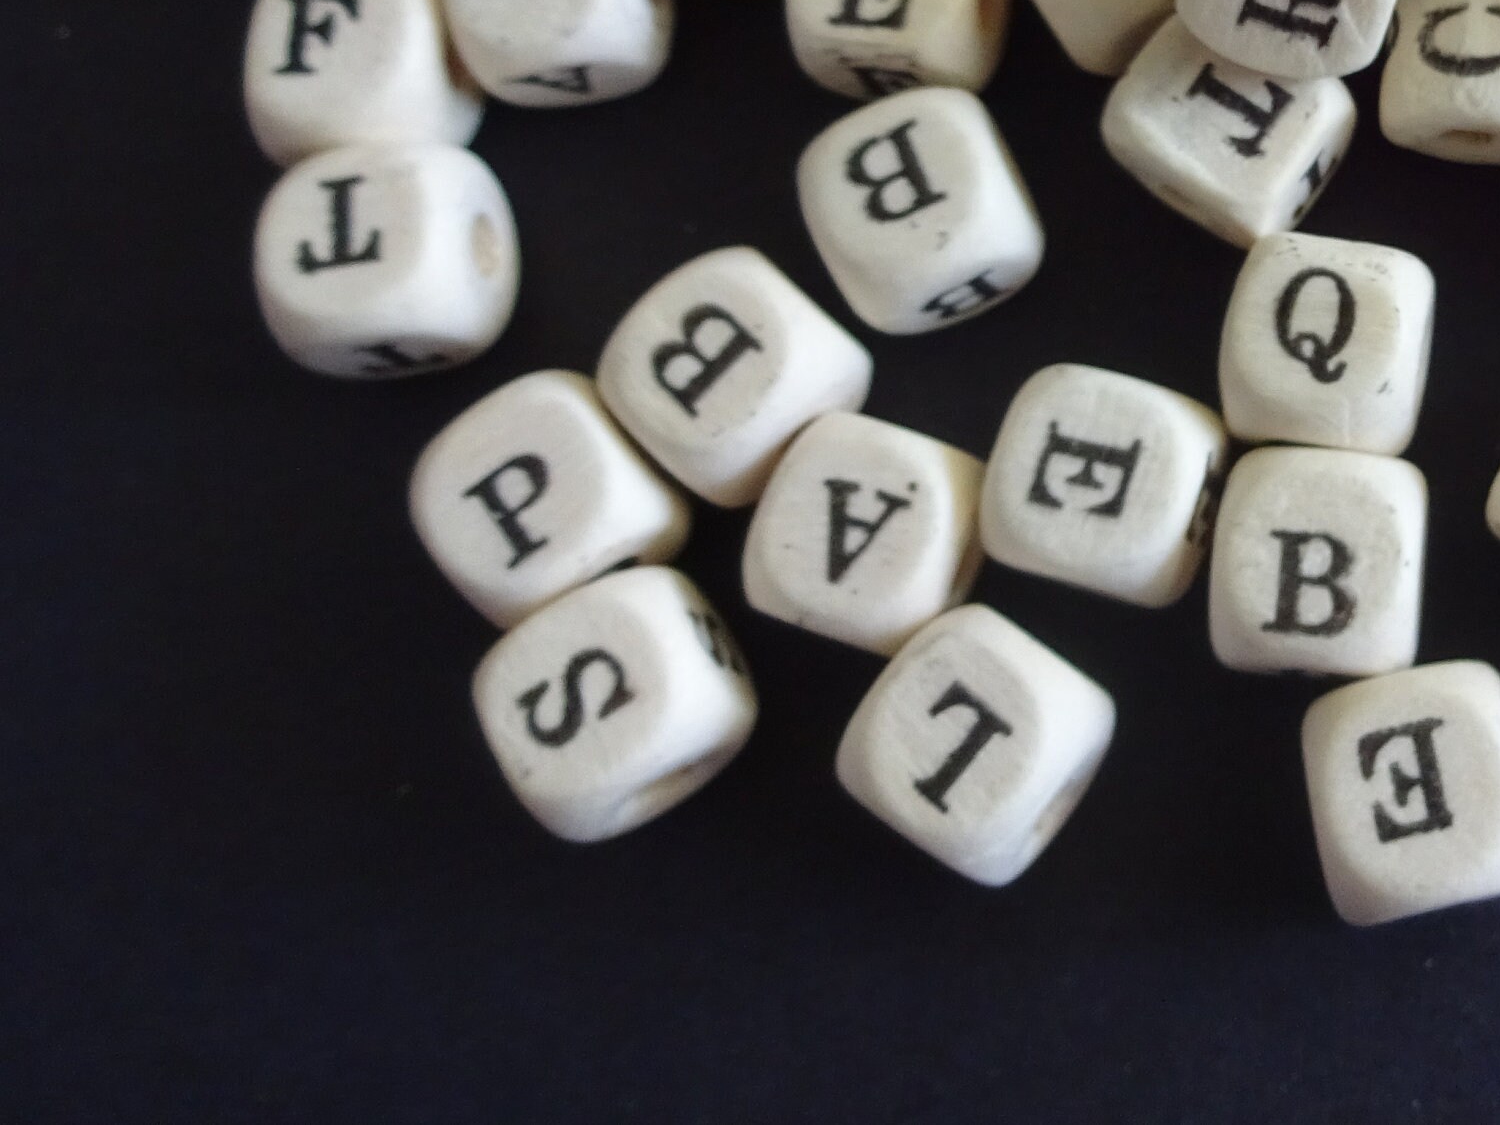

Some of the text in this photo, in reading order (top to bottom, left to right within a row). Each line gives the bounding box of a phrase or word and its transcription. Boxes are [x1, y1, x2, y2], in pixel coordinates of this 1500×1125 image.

[1185, 63, 1294, 160] T
[844, 116, 948, 223] B
[296, 175, 381, 274] T
[651, 302, 764, 419] B
[1274, 266, 1357, 385] Q
[461, 452, 552, 570] P
[1027, 418, 1143, 519] E
[822, 477, 912, 586] A
[1261, 529, 1357, 639] B
[515, 647, 637, 749] S
[1356, 716, 1454, 844] E
